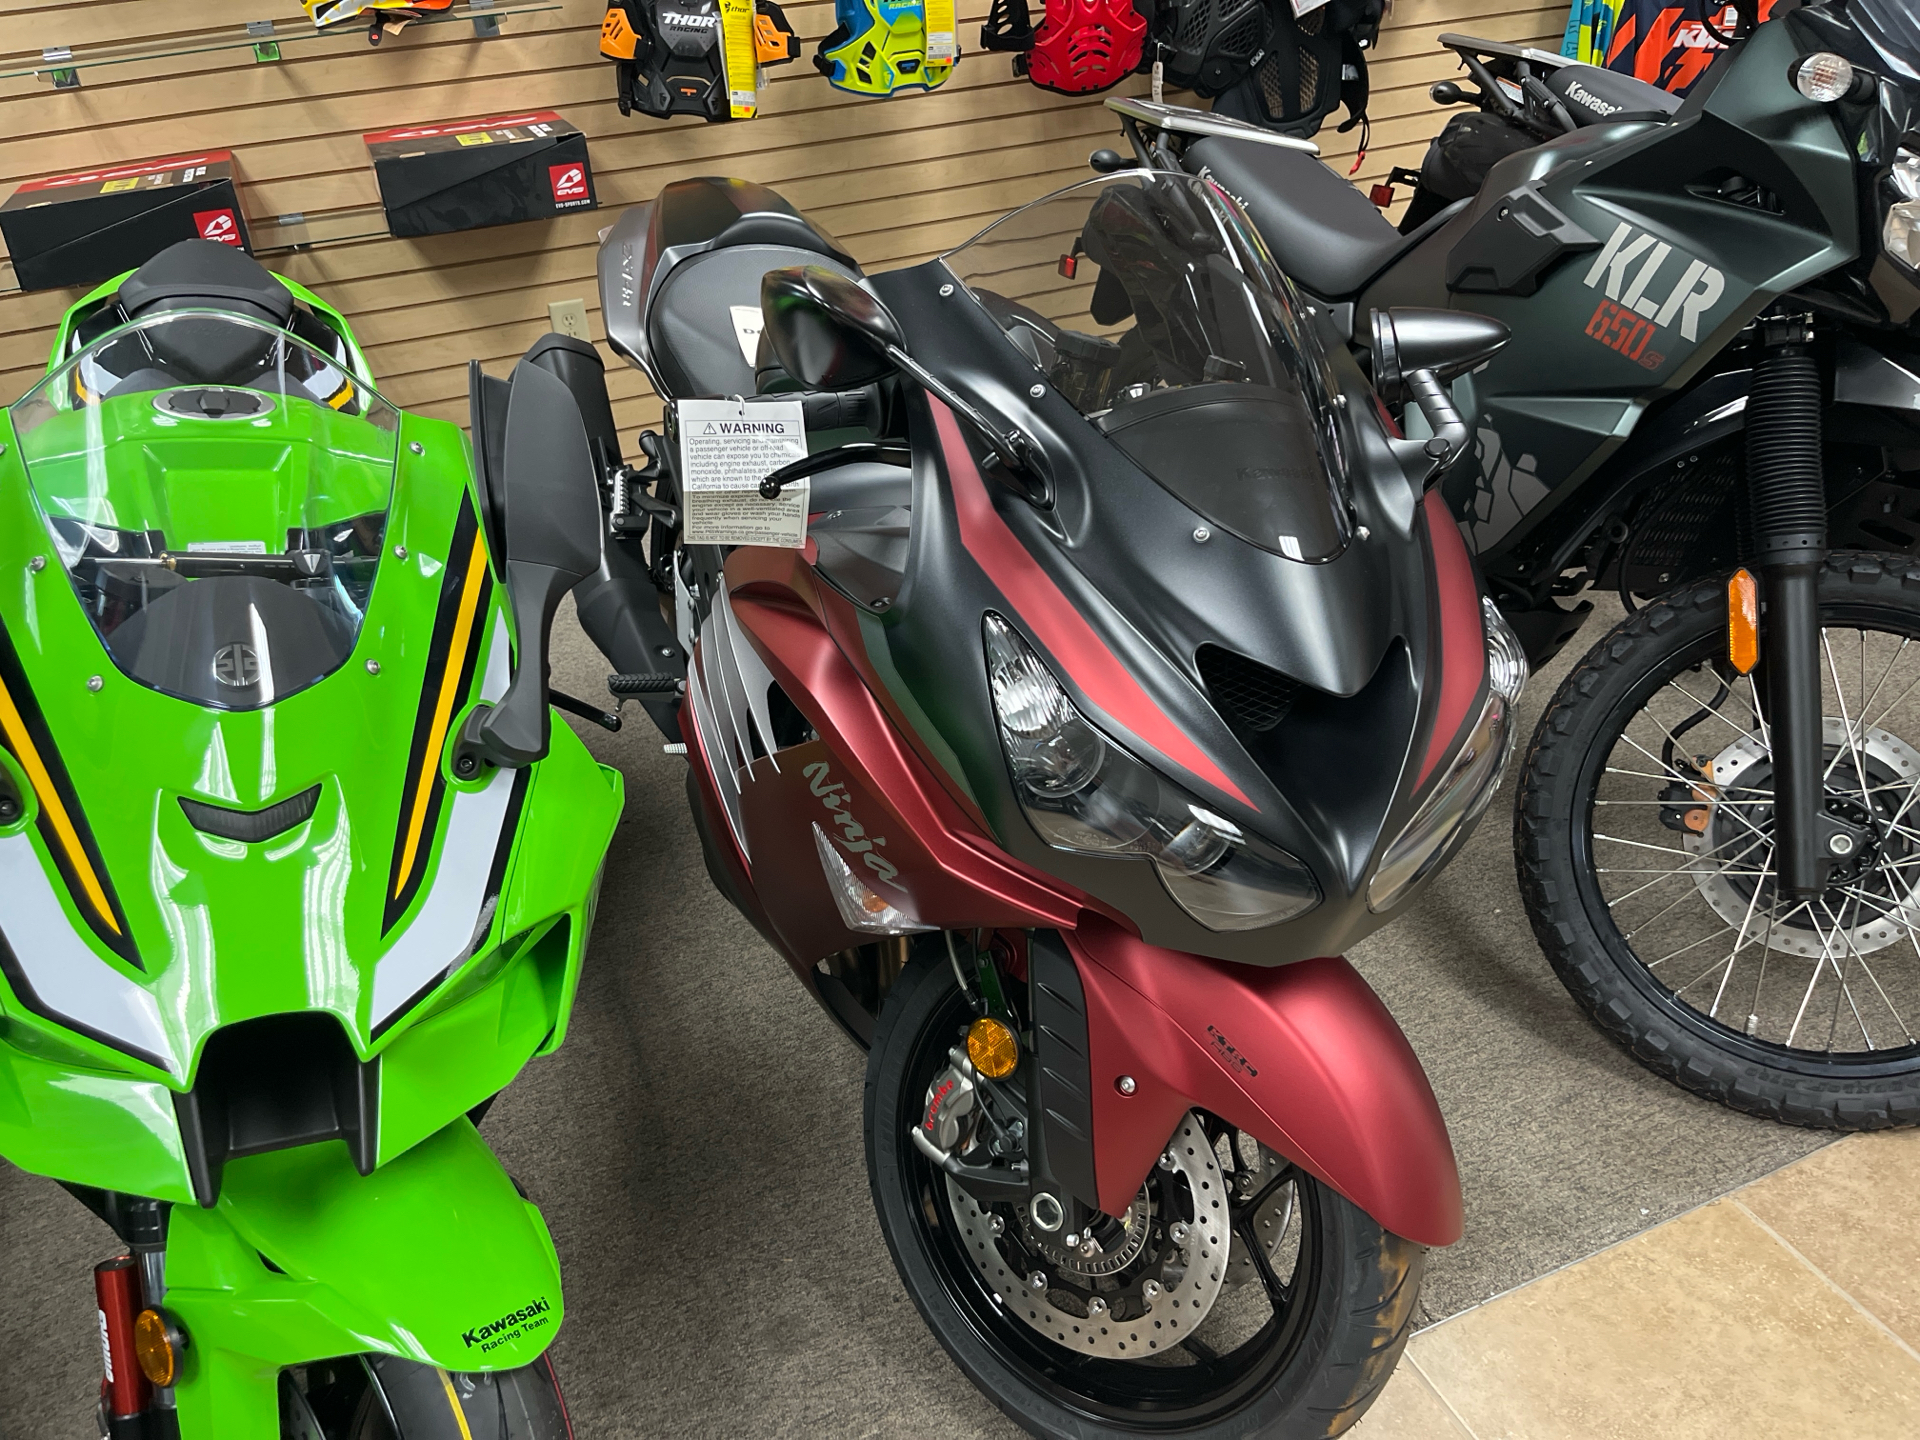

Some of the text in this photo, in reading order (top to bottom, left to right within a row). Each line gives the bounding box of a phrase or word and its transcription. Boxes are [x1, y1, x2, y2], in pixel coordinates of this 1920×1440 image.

[662, 12, 716, 28] THOR
[669, 26, 709, 34] RACING
[1565, 81, 1623, 117] Kawasa
[557, 186, 584, 196] EVS
[1583, 221, 1725, 343] KLR
[1584, 298, 1656, 361] 650
[689, 438, 722, 446] Operating,
[723, 437, 751, 446] servicing
[719, 423, 785, 434] WARNING
[690, 461, 718, 469] including
[719, 460, 741, 468] engine
[726, 453, 749, 461] expose
[803, 761, 909, 893] Ninja
[925, 1080, 953, 1131] brembo
[461, 1296, 550, 1348] Kawasaki
[481, 1316, 549, 1353] Racing Team
